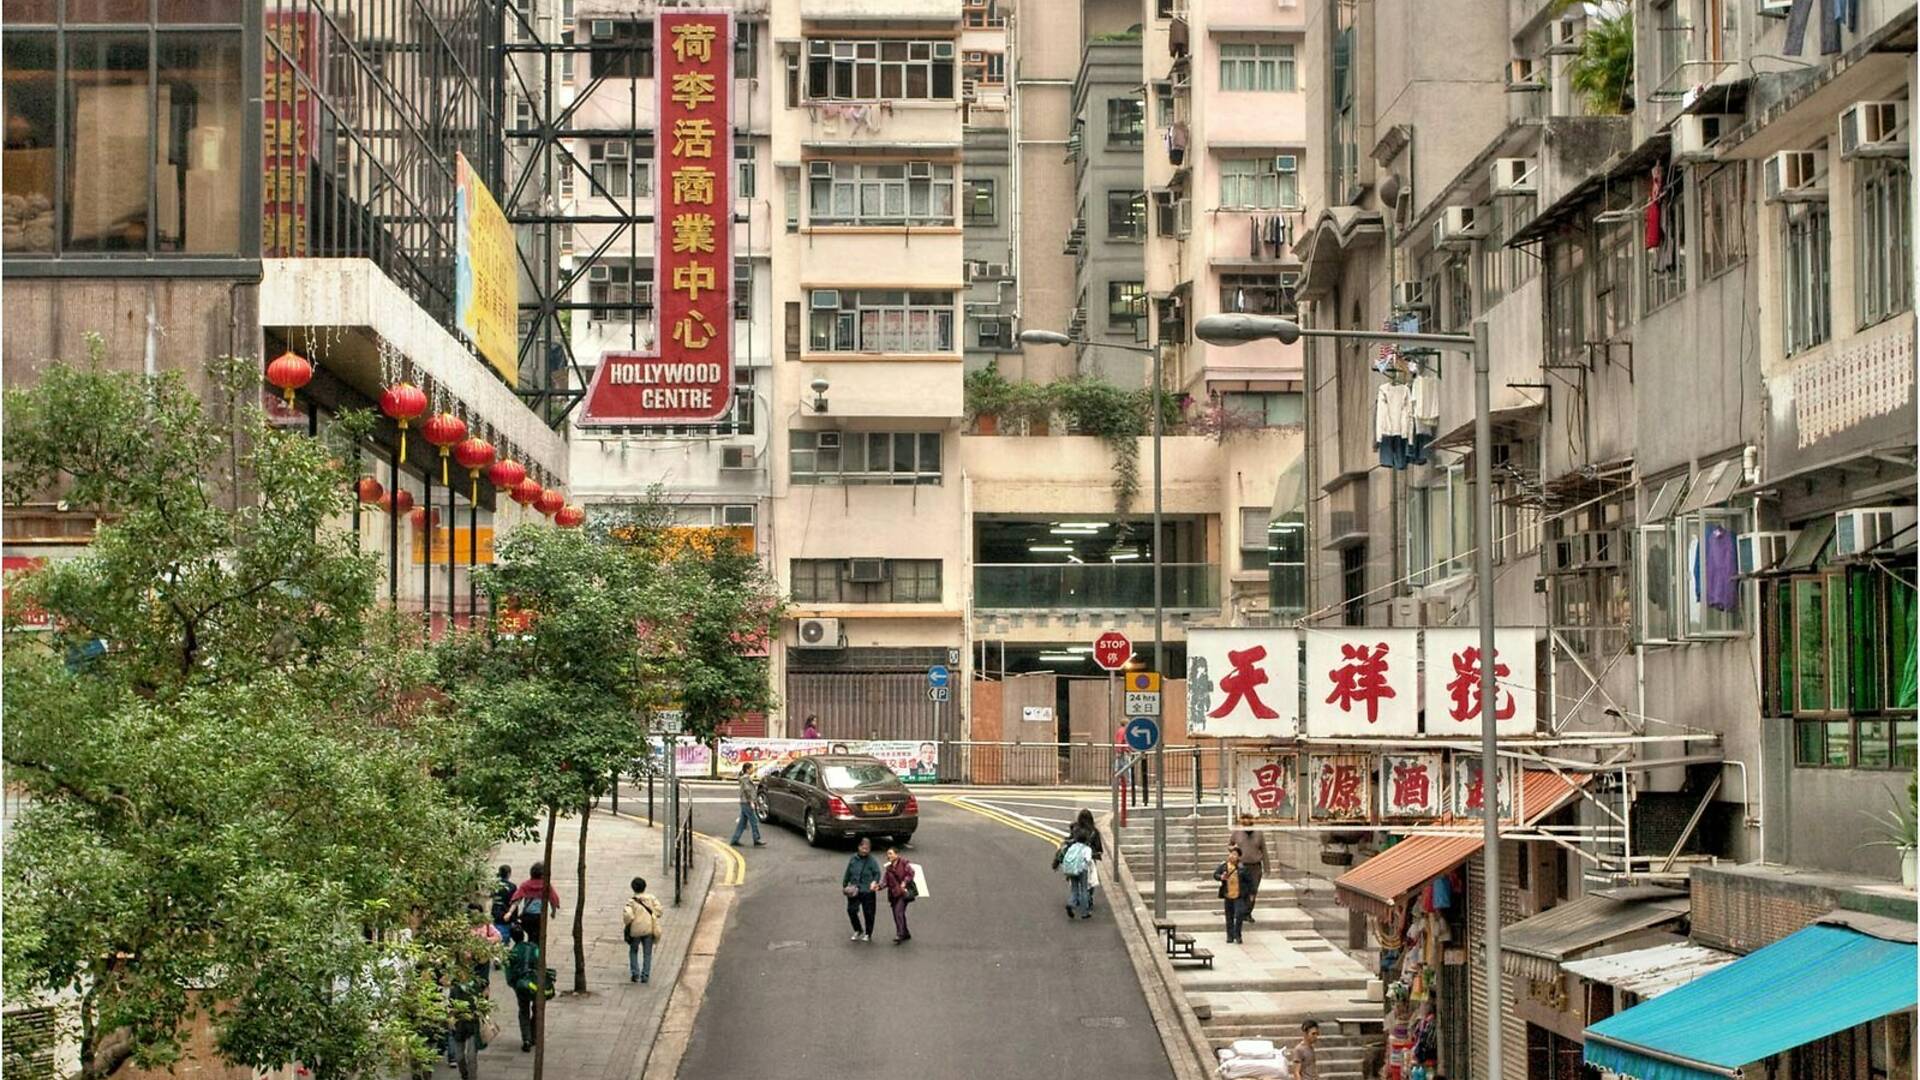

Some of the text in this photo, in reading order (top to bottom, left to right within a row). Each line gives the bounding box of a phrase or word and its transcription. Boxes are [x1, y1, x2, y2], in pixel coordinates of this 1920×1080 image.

[671, 23, 718, 350] 荷李活商業中心
[610, 362, 721, 386] HOLLYWOOD
[641, 388, 713, 410] CENTRE
[1100, 640, 1126, 649] STOP
[1107, 652, 1118, 663] 停
[938, 689, 946, 699] P
[1129, 693, 1156, 702] 24 hrs
[1132, 703, 1153, 713] 全日
